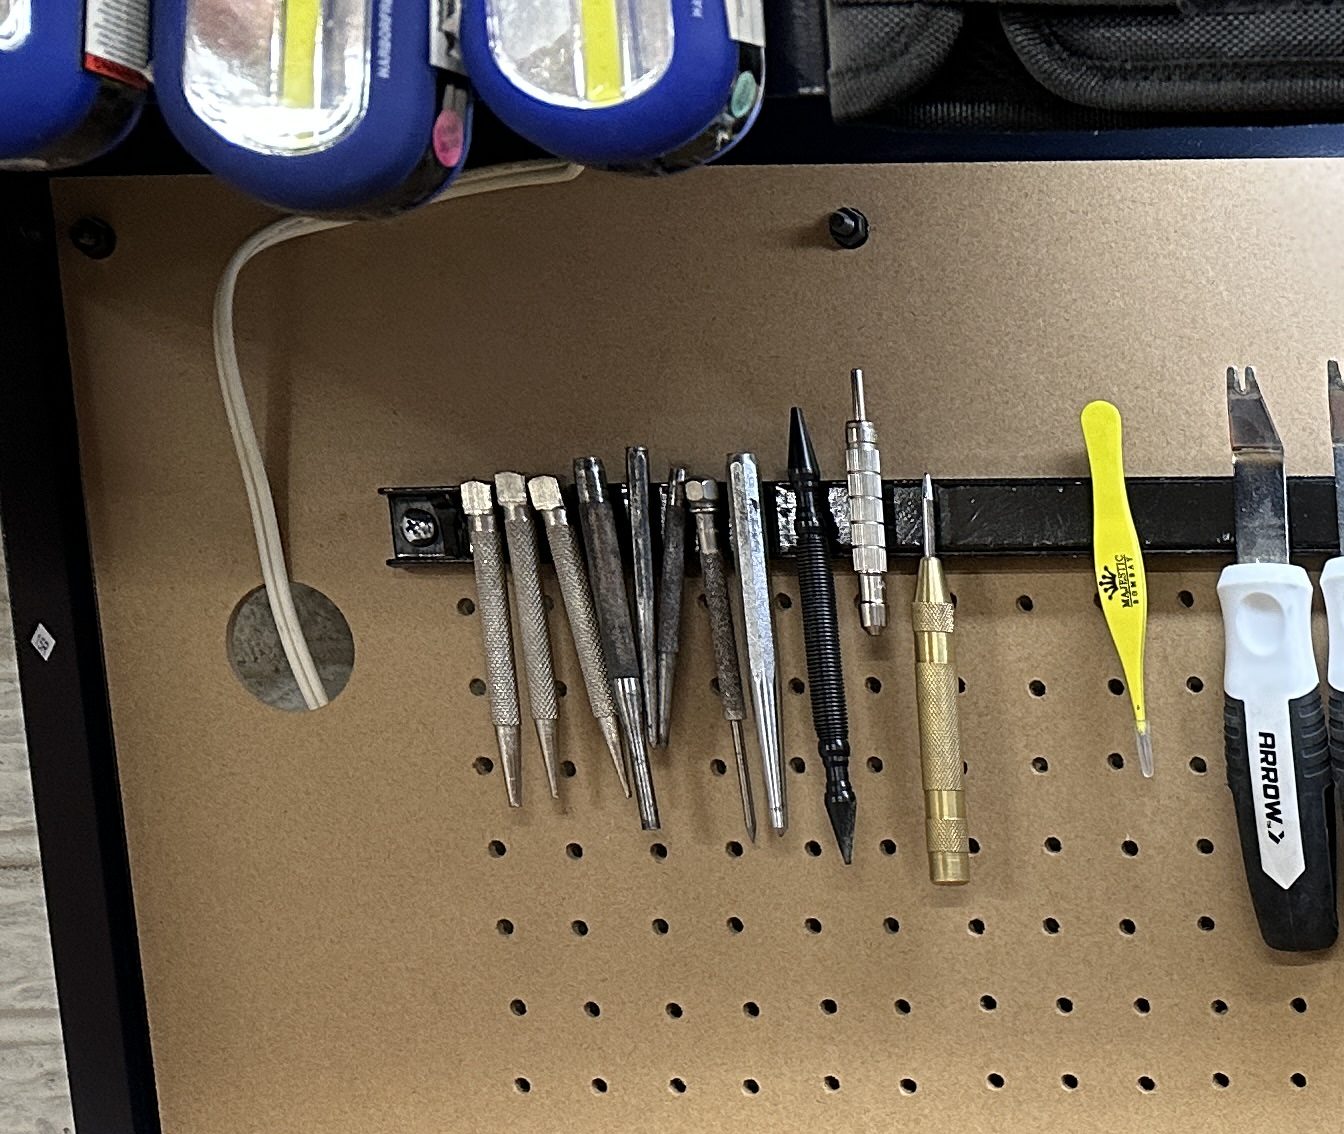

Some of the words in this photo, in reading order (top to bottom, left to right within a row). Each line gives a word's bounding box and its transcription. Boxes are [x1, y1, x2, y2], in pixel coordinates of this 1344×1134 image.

[1115, 554, 1131, 608] MAJESTIC
[1126, 556, 1139, 605] BOMBAY
[1258, 731, 1284, 825] ARROW
